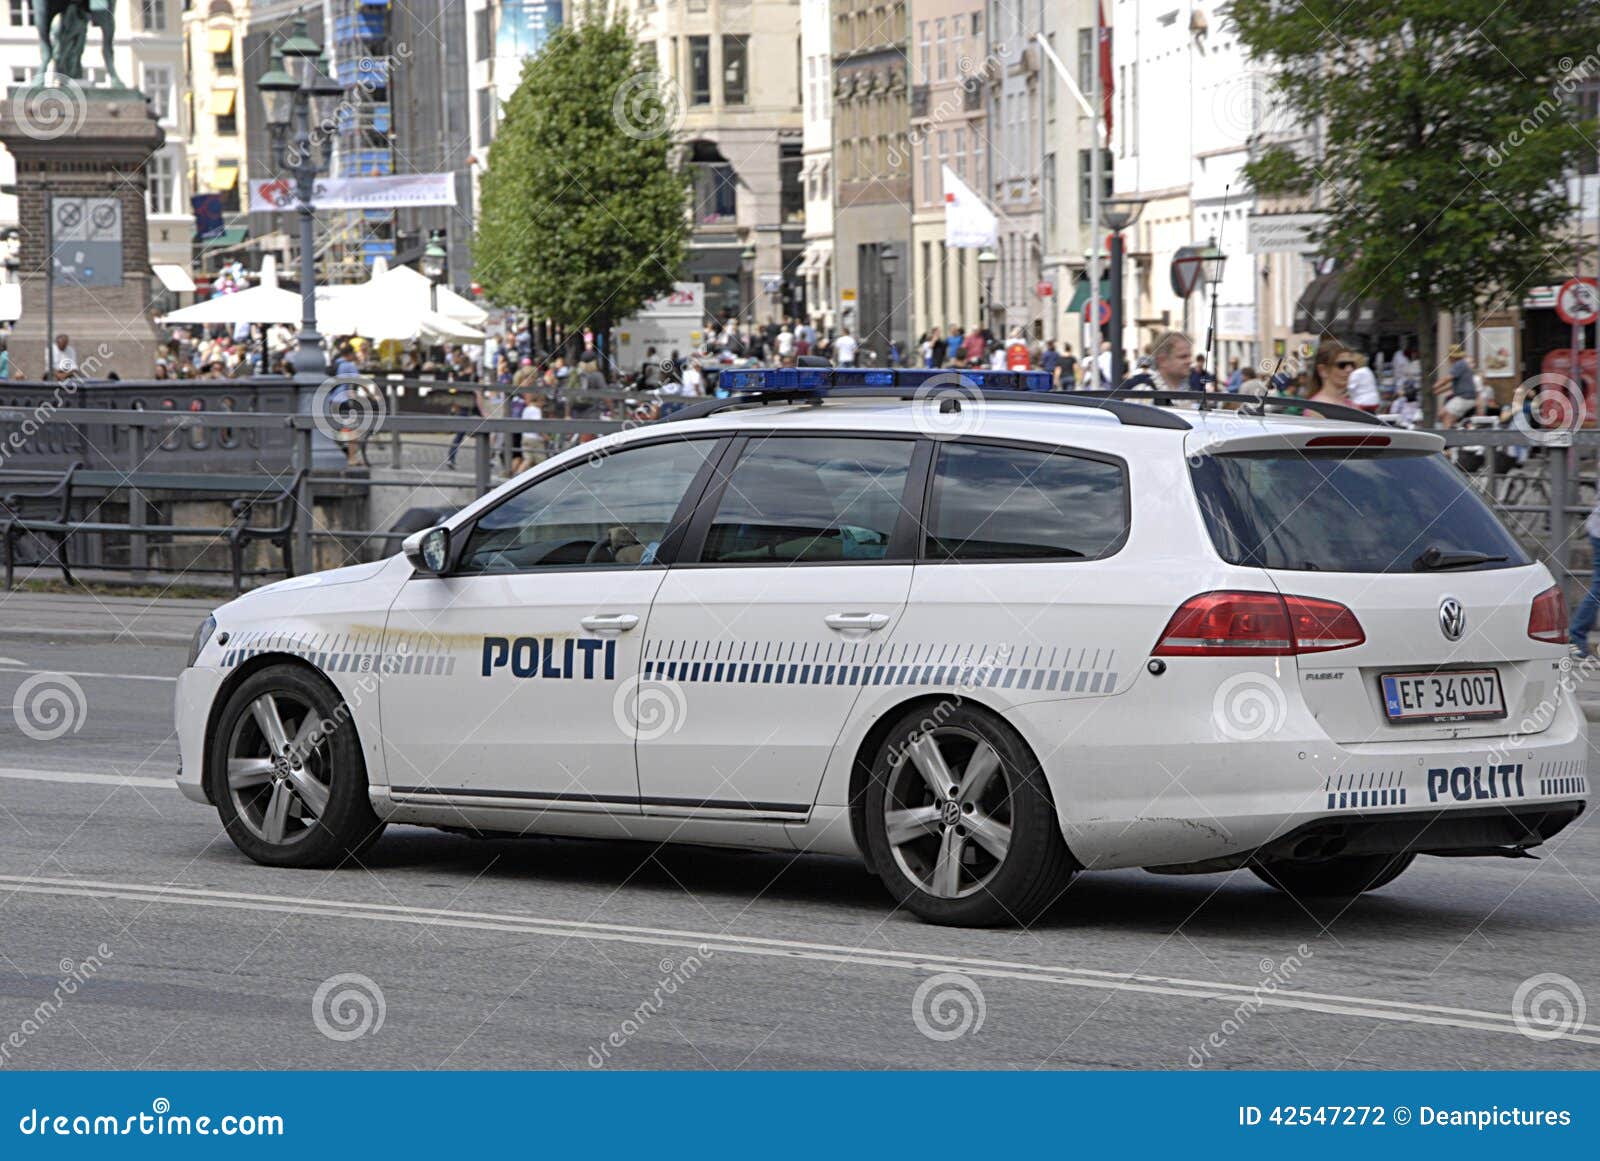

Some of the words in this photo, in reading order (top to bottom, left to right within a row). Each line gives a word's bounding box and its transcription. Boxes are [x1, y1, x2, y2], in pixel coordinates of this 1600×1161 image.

[482, 637, 616, 680] POLITI
[1400, 680, 1425, 709] EF
[1427, 764, 1524, 802] POLITI
